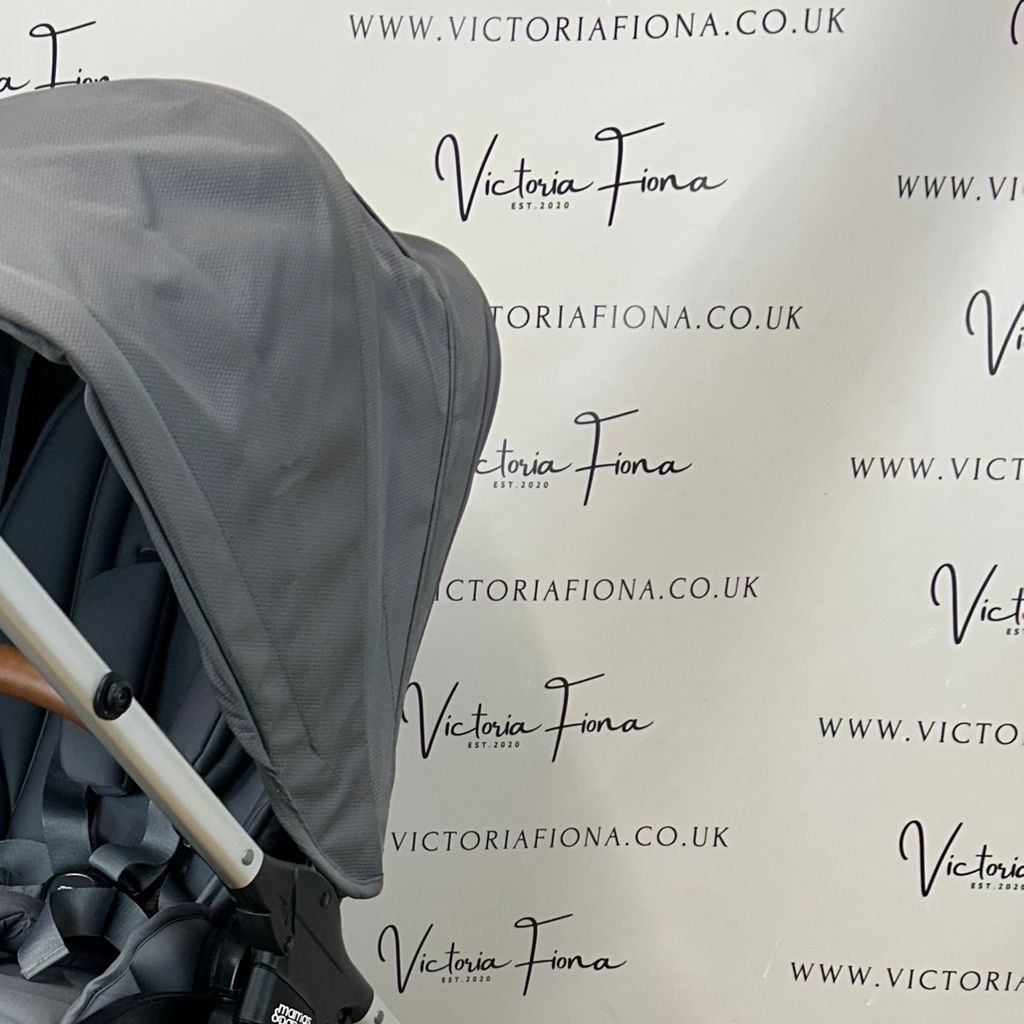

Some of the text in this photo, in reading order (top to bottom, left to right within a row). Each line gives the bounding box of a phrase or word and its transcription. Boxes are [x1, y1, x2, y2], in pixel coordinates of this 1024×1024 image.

[350, 8, 846, 42] WWW.VICTORIAFIONA.CO.UK
[434, 122, 728, 227] Victoria Fiona
[510, 202, 571, 210] EST.2020
[489, 305, 804, 330] TORIAFIONA.CO.UK
[474, 409, 694, 507] ctoria Fiona
[492, 481, 550, 489] EST.2020
[435, 576, 761, 602] ICTORIAFIONA.CO.UK
[401, 673, 655, 763] Victoria Fiona
[391, 825, 731, 852] VICTORIAFIONA.CO.UK
[378, 913, 628, 997] Victoria Fiona
[441, 976, 492, 984] EST.2020
